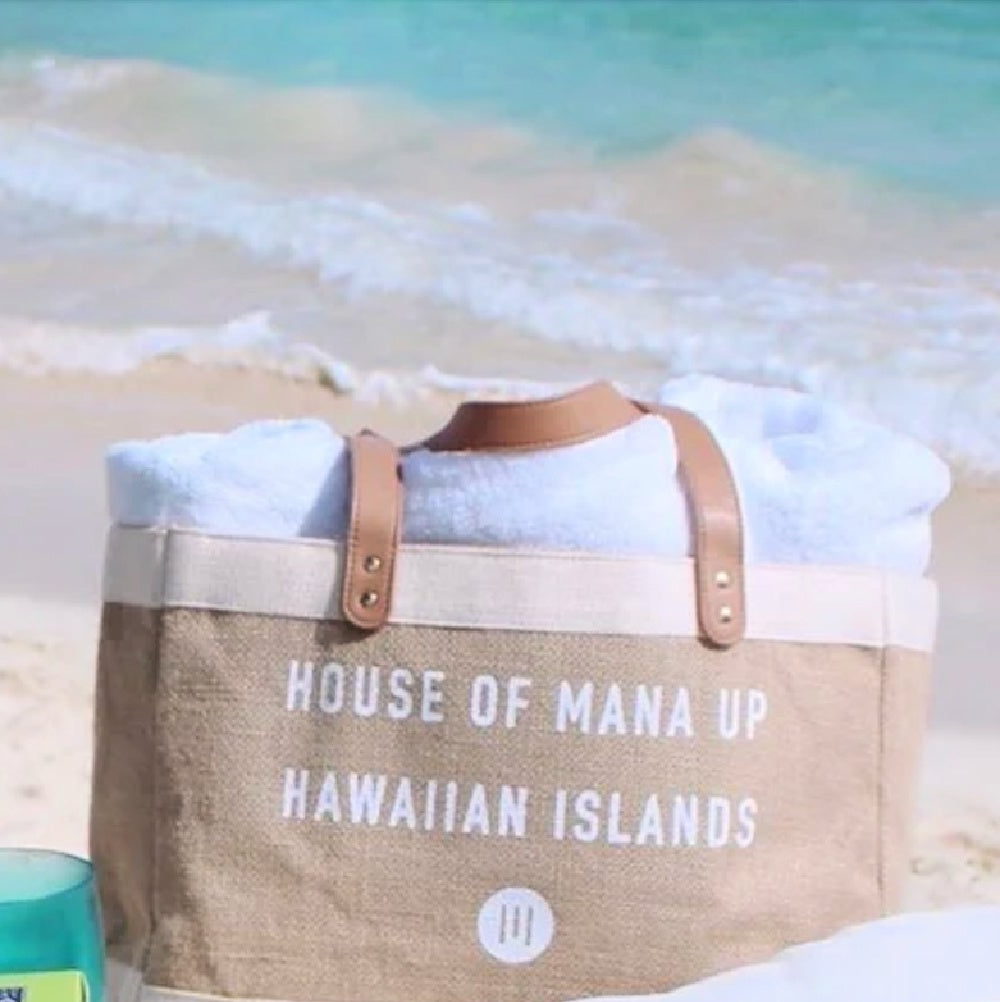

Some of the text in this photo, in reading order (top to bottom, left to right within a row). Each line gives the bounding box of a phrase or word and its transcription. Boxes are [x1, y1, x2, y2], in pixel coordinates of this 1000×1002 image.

[286, 659, 769, 742] HOUSE OF MANA UP
[282, 768, 758, 848] HAWAIIAN ISLANDS
